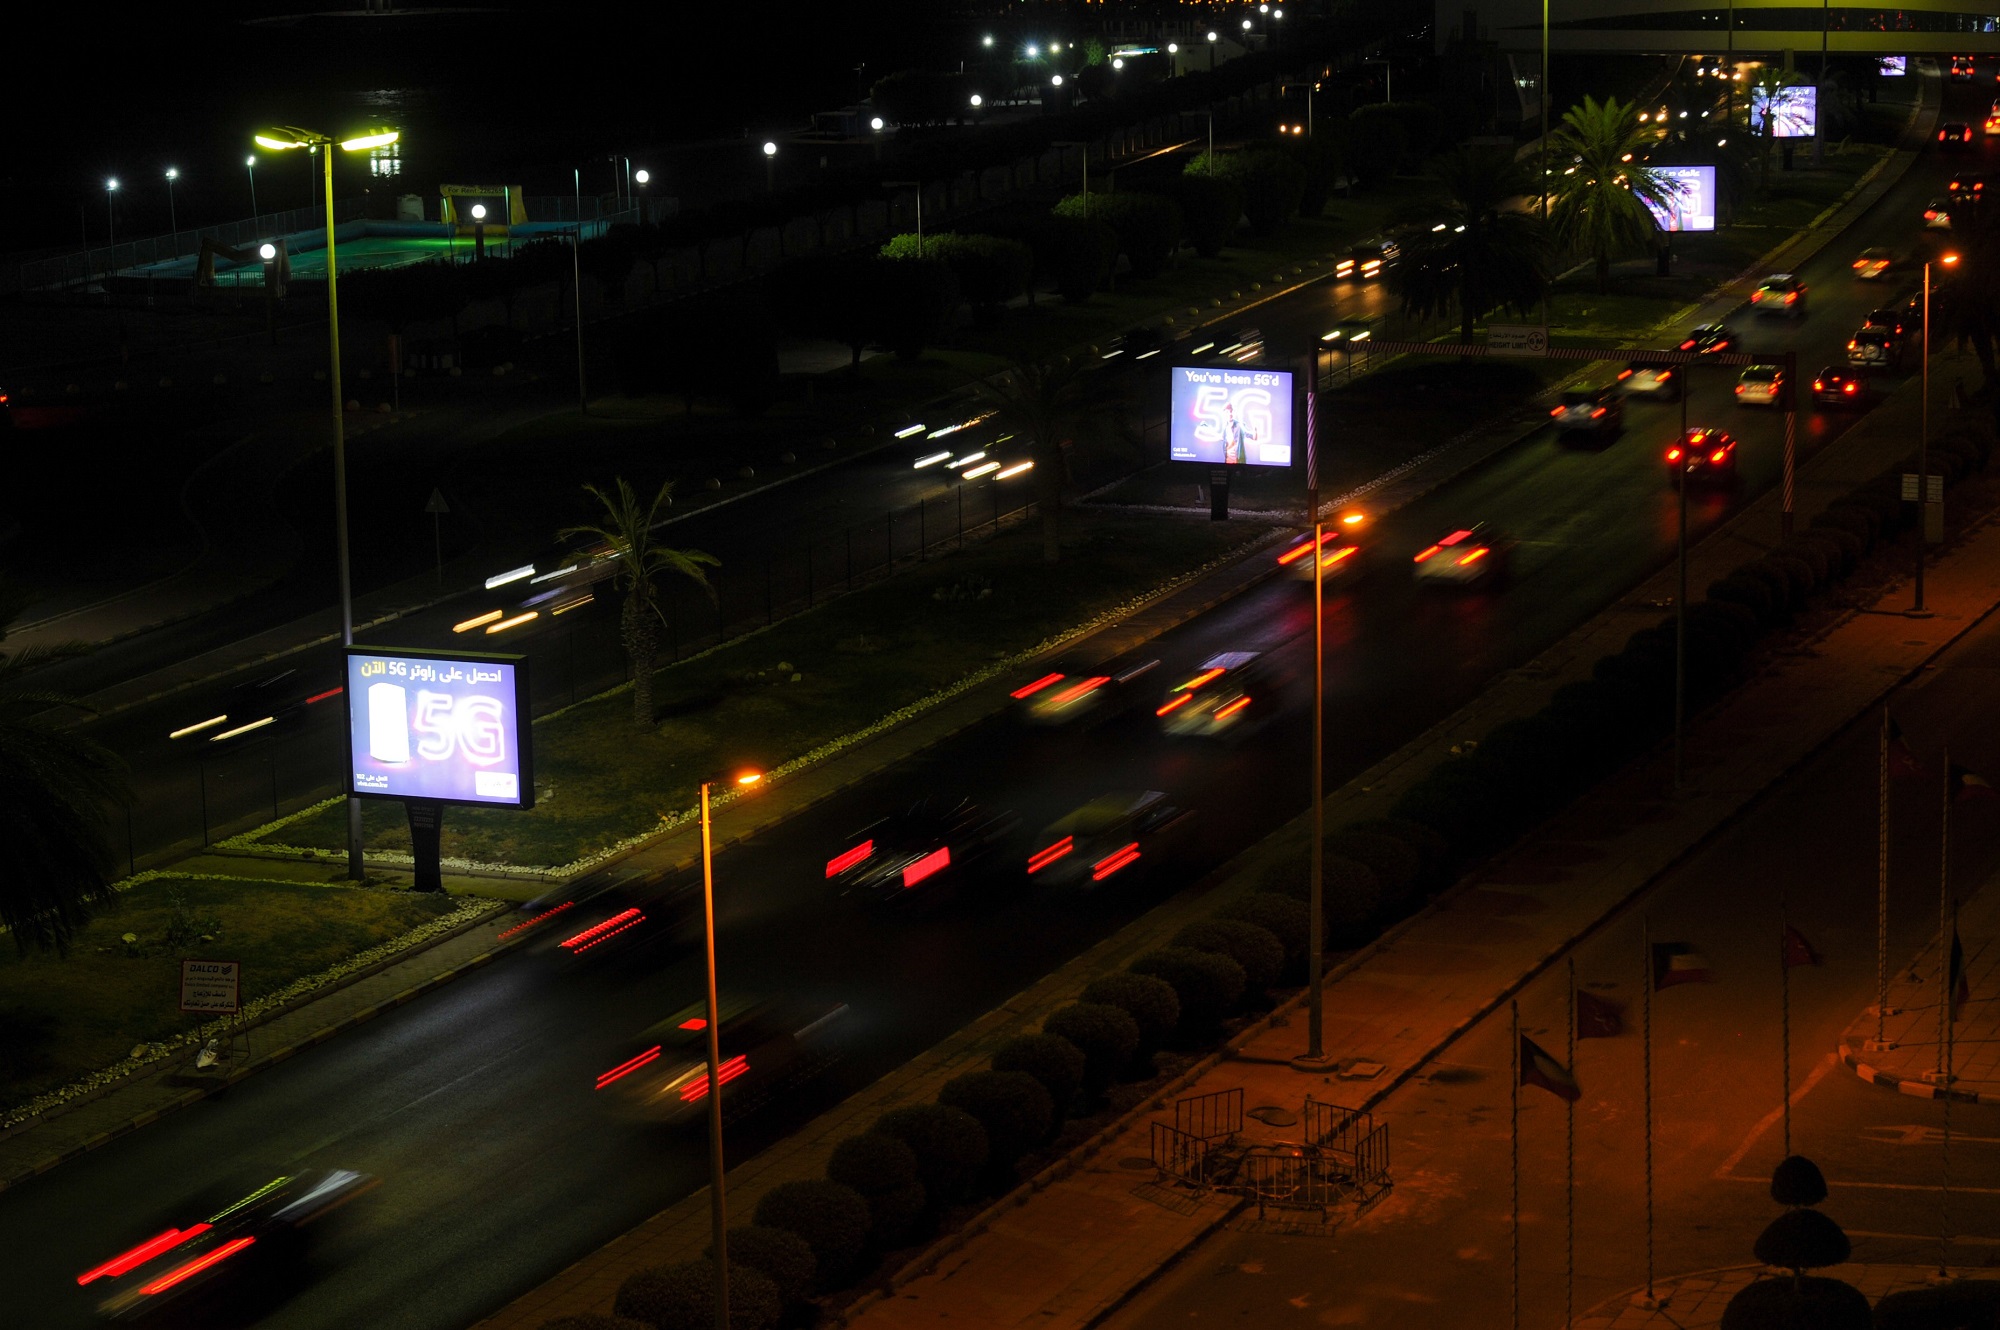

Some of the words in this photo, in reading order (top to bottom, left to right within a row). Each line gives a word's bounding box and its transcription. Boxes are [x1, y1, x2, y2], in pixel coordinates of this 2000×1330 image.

[1186, 370, 1221, 384] You've
[1224, 372, 1251, 385] been
[1254, 374, 1280, 386] 5G'd
[1193, 386, 1272, 444] 5G
[361, 661, 386, 678] الآن
[389, 662, 407, 676] 5G
[409, 664, 435, 682] راوتر
[439, 666, 463, 683] على
[466, 668, 502, 684] احصل
[414, 690, 505, 766] 5G
